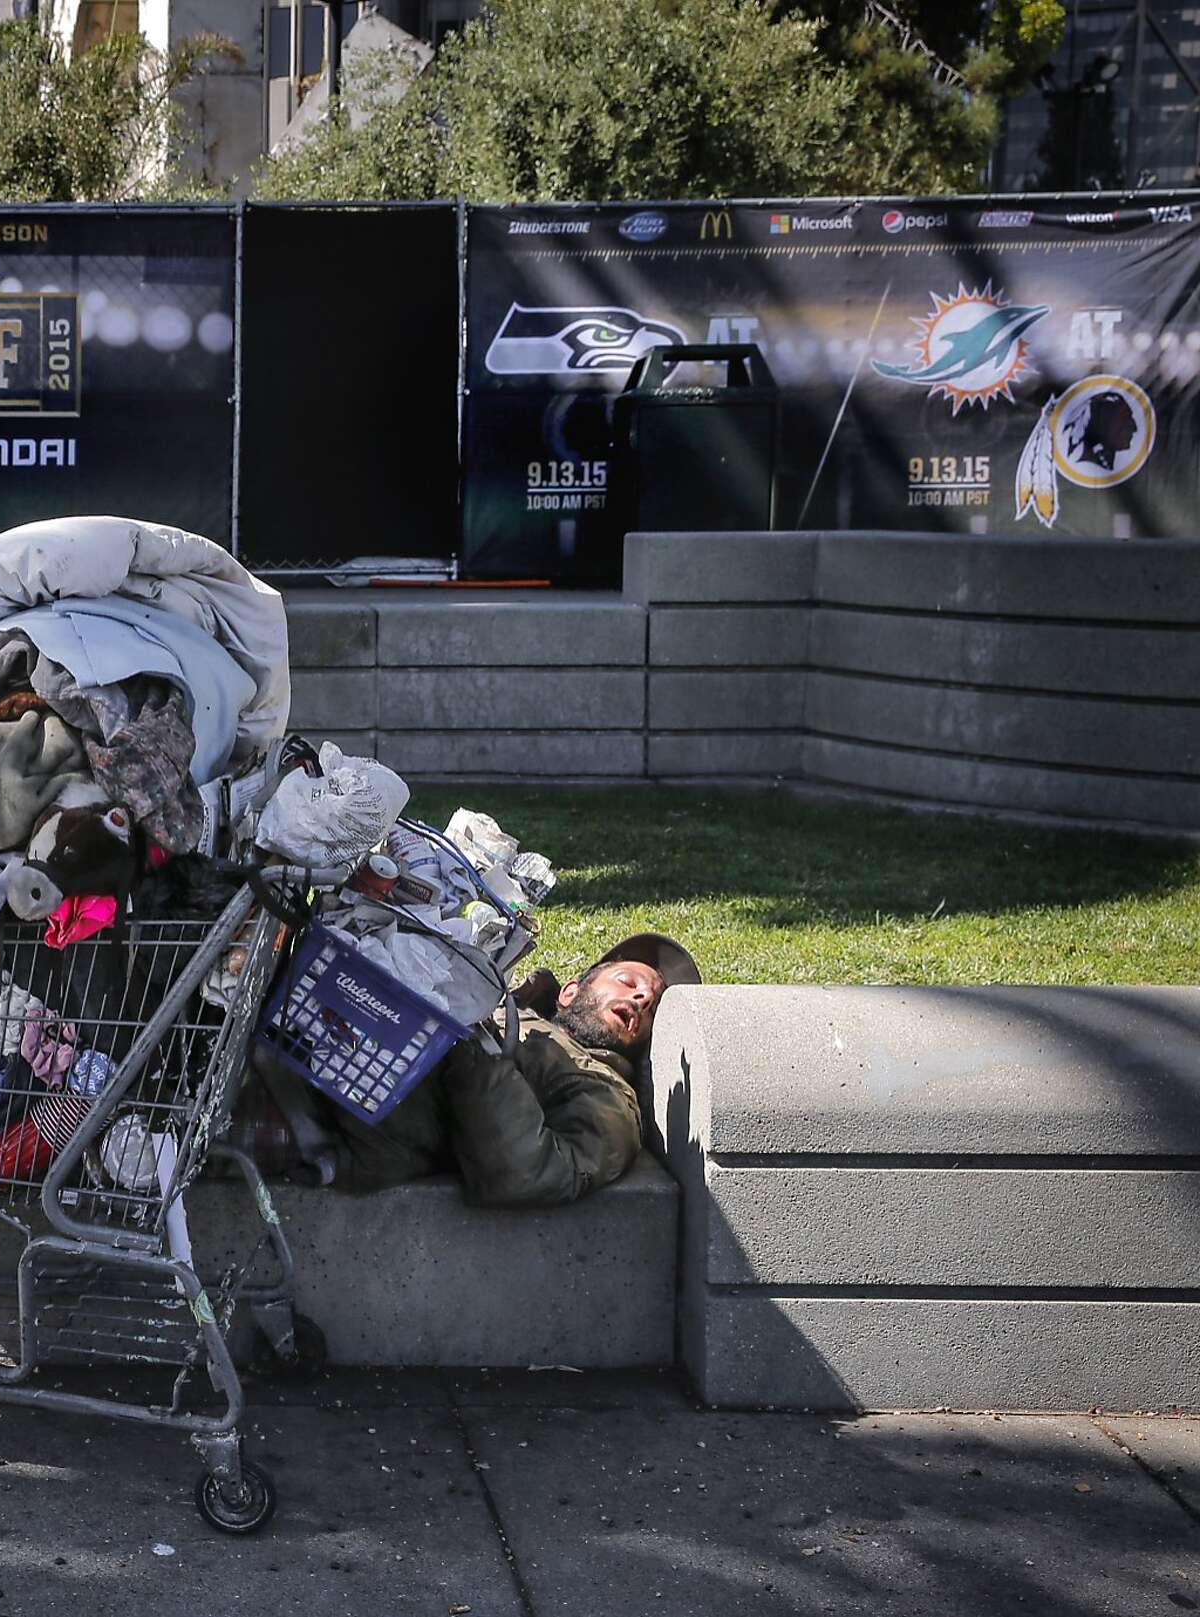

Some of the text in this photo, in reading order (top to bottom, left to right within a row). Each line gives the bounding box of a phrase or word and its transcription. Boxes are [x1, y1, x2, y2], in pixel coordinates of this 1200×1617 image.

[792, 215, 853, 230] Microsoft
[905, 212, 948, 230] pepsi
[1066, 212, 1113, 223] verizon
[1149, 206, 1193, 224] VISA
[508, 221, 591, 234] BRIDGESTONE
[1067, 311, 1121, 359] AT
[48, 318, 70, 391] 2015
[527, 461, 607, 487] 9.13.15
[909, 456, 990, 483] 9.13.15
[527, 494, 607, 510] 10:00 AM PST
[907, 490, 991, 506] 10:00 AM PST
[336, 972, 400, 1024] Walgreens
